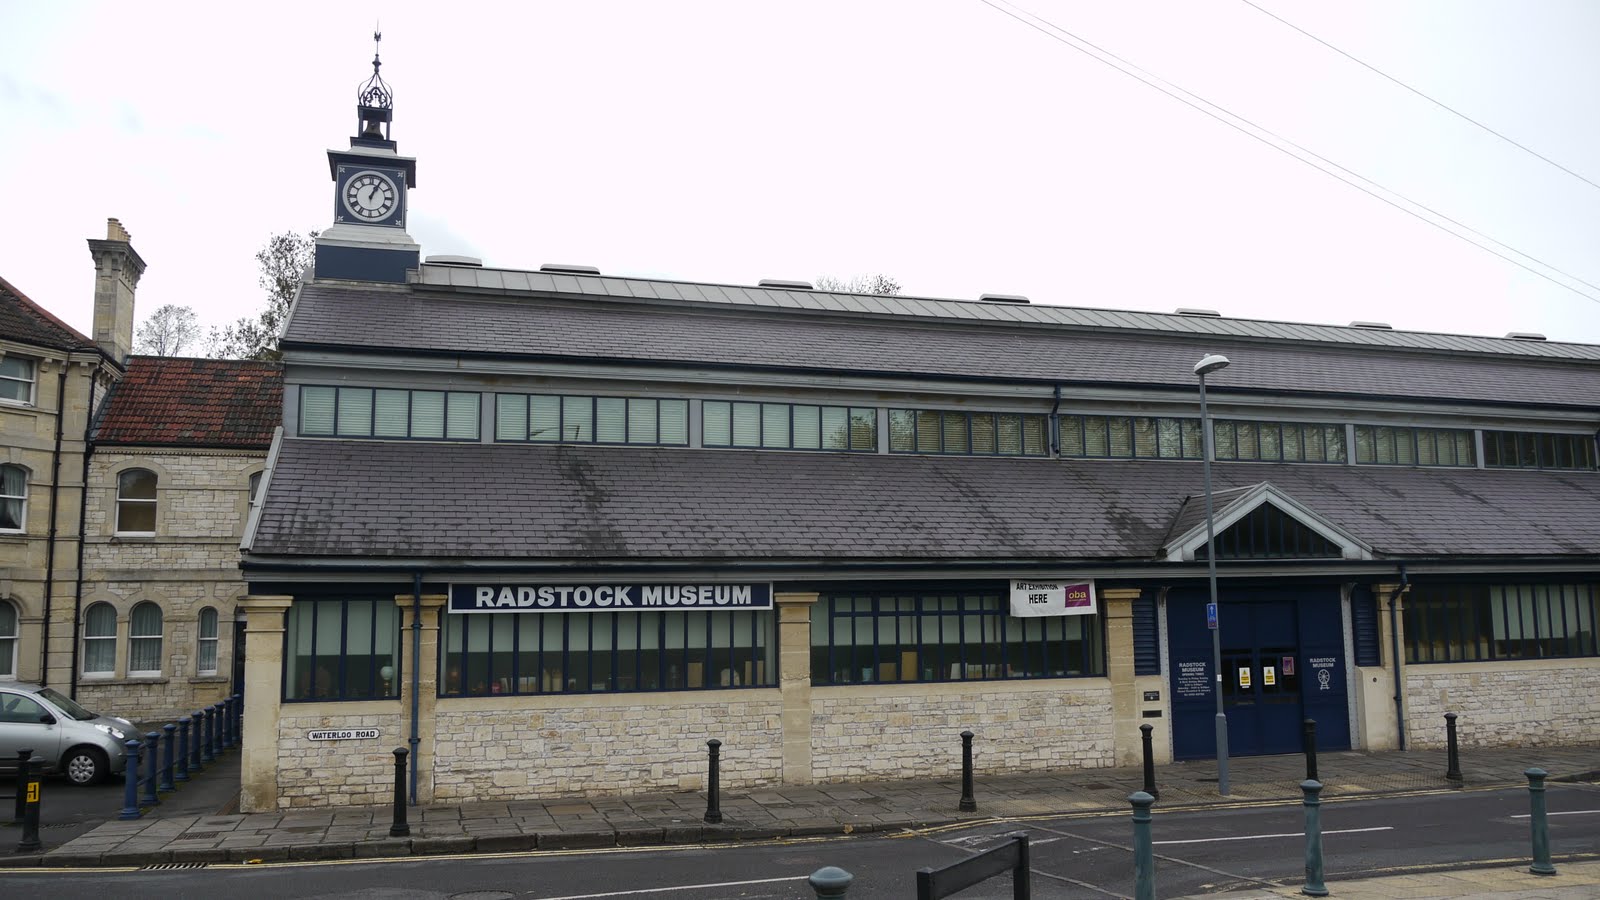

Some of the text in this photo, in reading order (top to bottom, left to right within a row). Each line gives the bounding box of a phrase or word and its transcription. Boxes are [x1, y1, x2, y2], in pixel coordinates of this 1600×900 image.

[1016, 582, 1027, 590] ART
[475, 585, 752, 608] RADSTOCK MUSEUM
[1028, 593, 1048, 604] HERE
[1068, 590, 1087, 599] oba
[312, 730, 375, 739] WATERLOO ROAD
